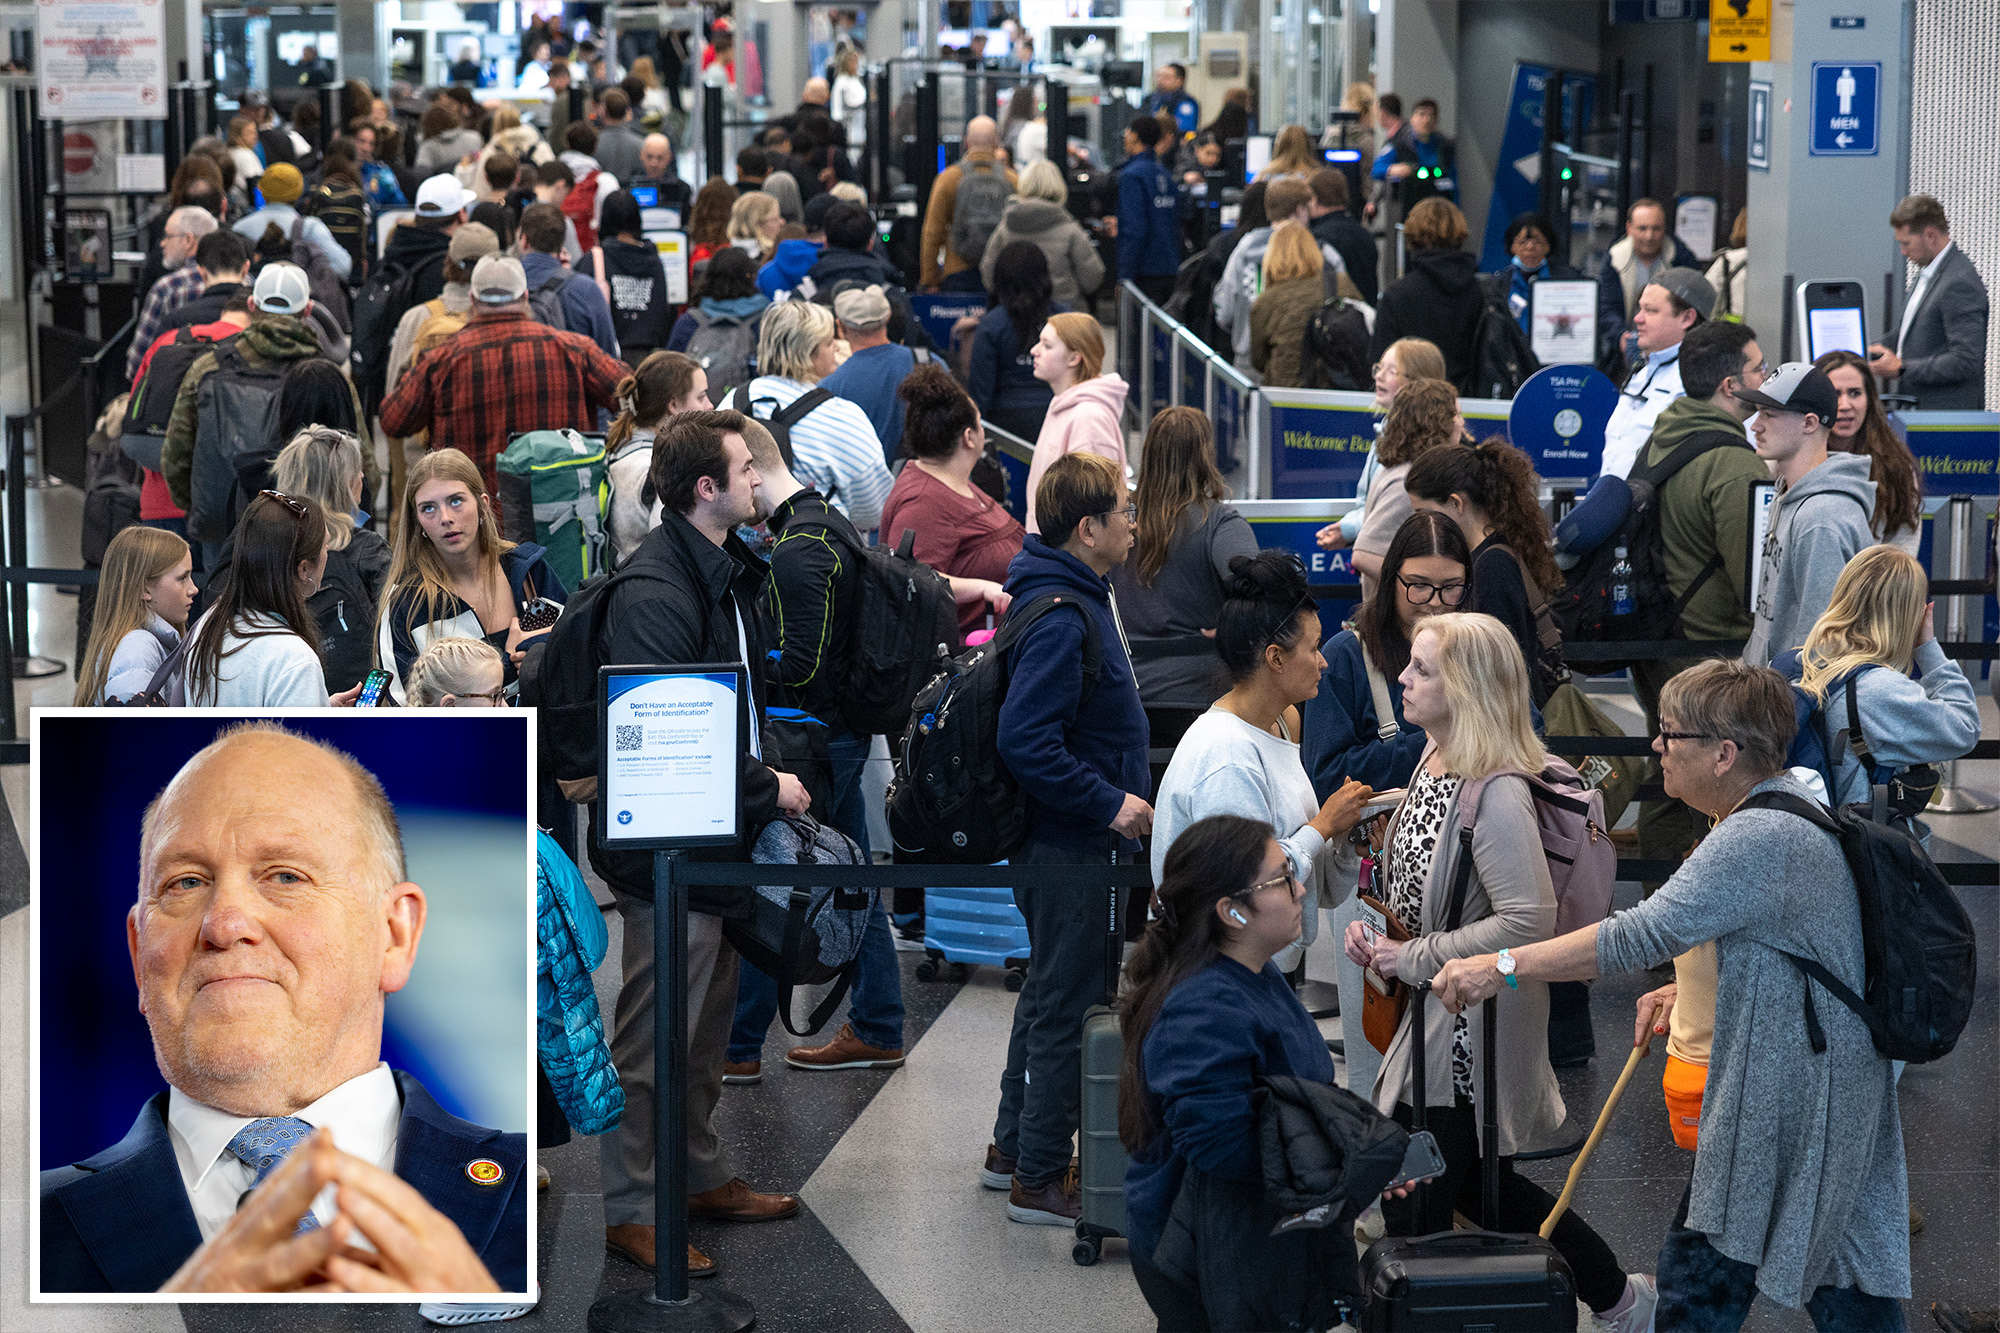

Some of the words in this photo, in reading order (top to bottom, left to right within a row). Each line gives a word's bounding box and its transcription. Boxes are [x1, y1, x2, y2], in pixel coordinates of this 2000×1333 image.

[1830, 116, 1860, 130] MEN
[930, 305, 966, 319] Please
[1549, 376, 1565, 387] TSA
[1284, 430, 1348, 452] Welcome
[1543, 449, 1568, 459] Enroll
[1568, 449, 1589, 459] Now
[1919, 454, 1994, 475] Welcome
[661, 709, 709, 717] Identification?
